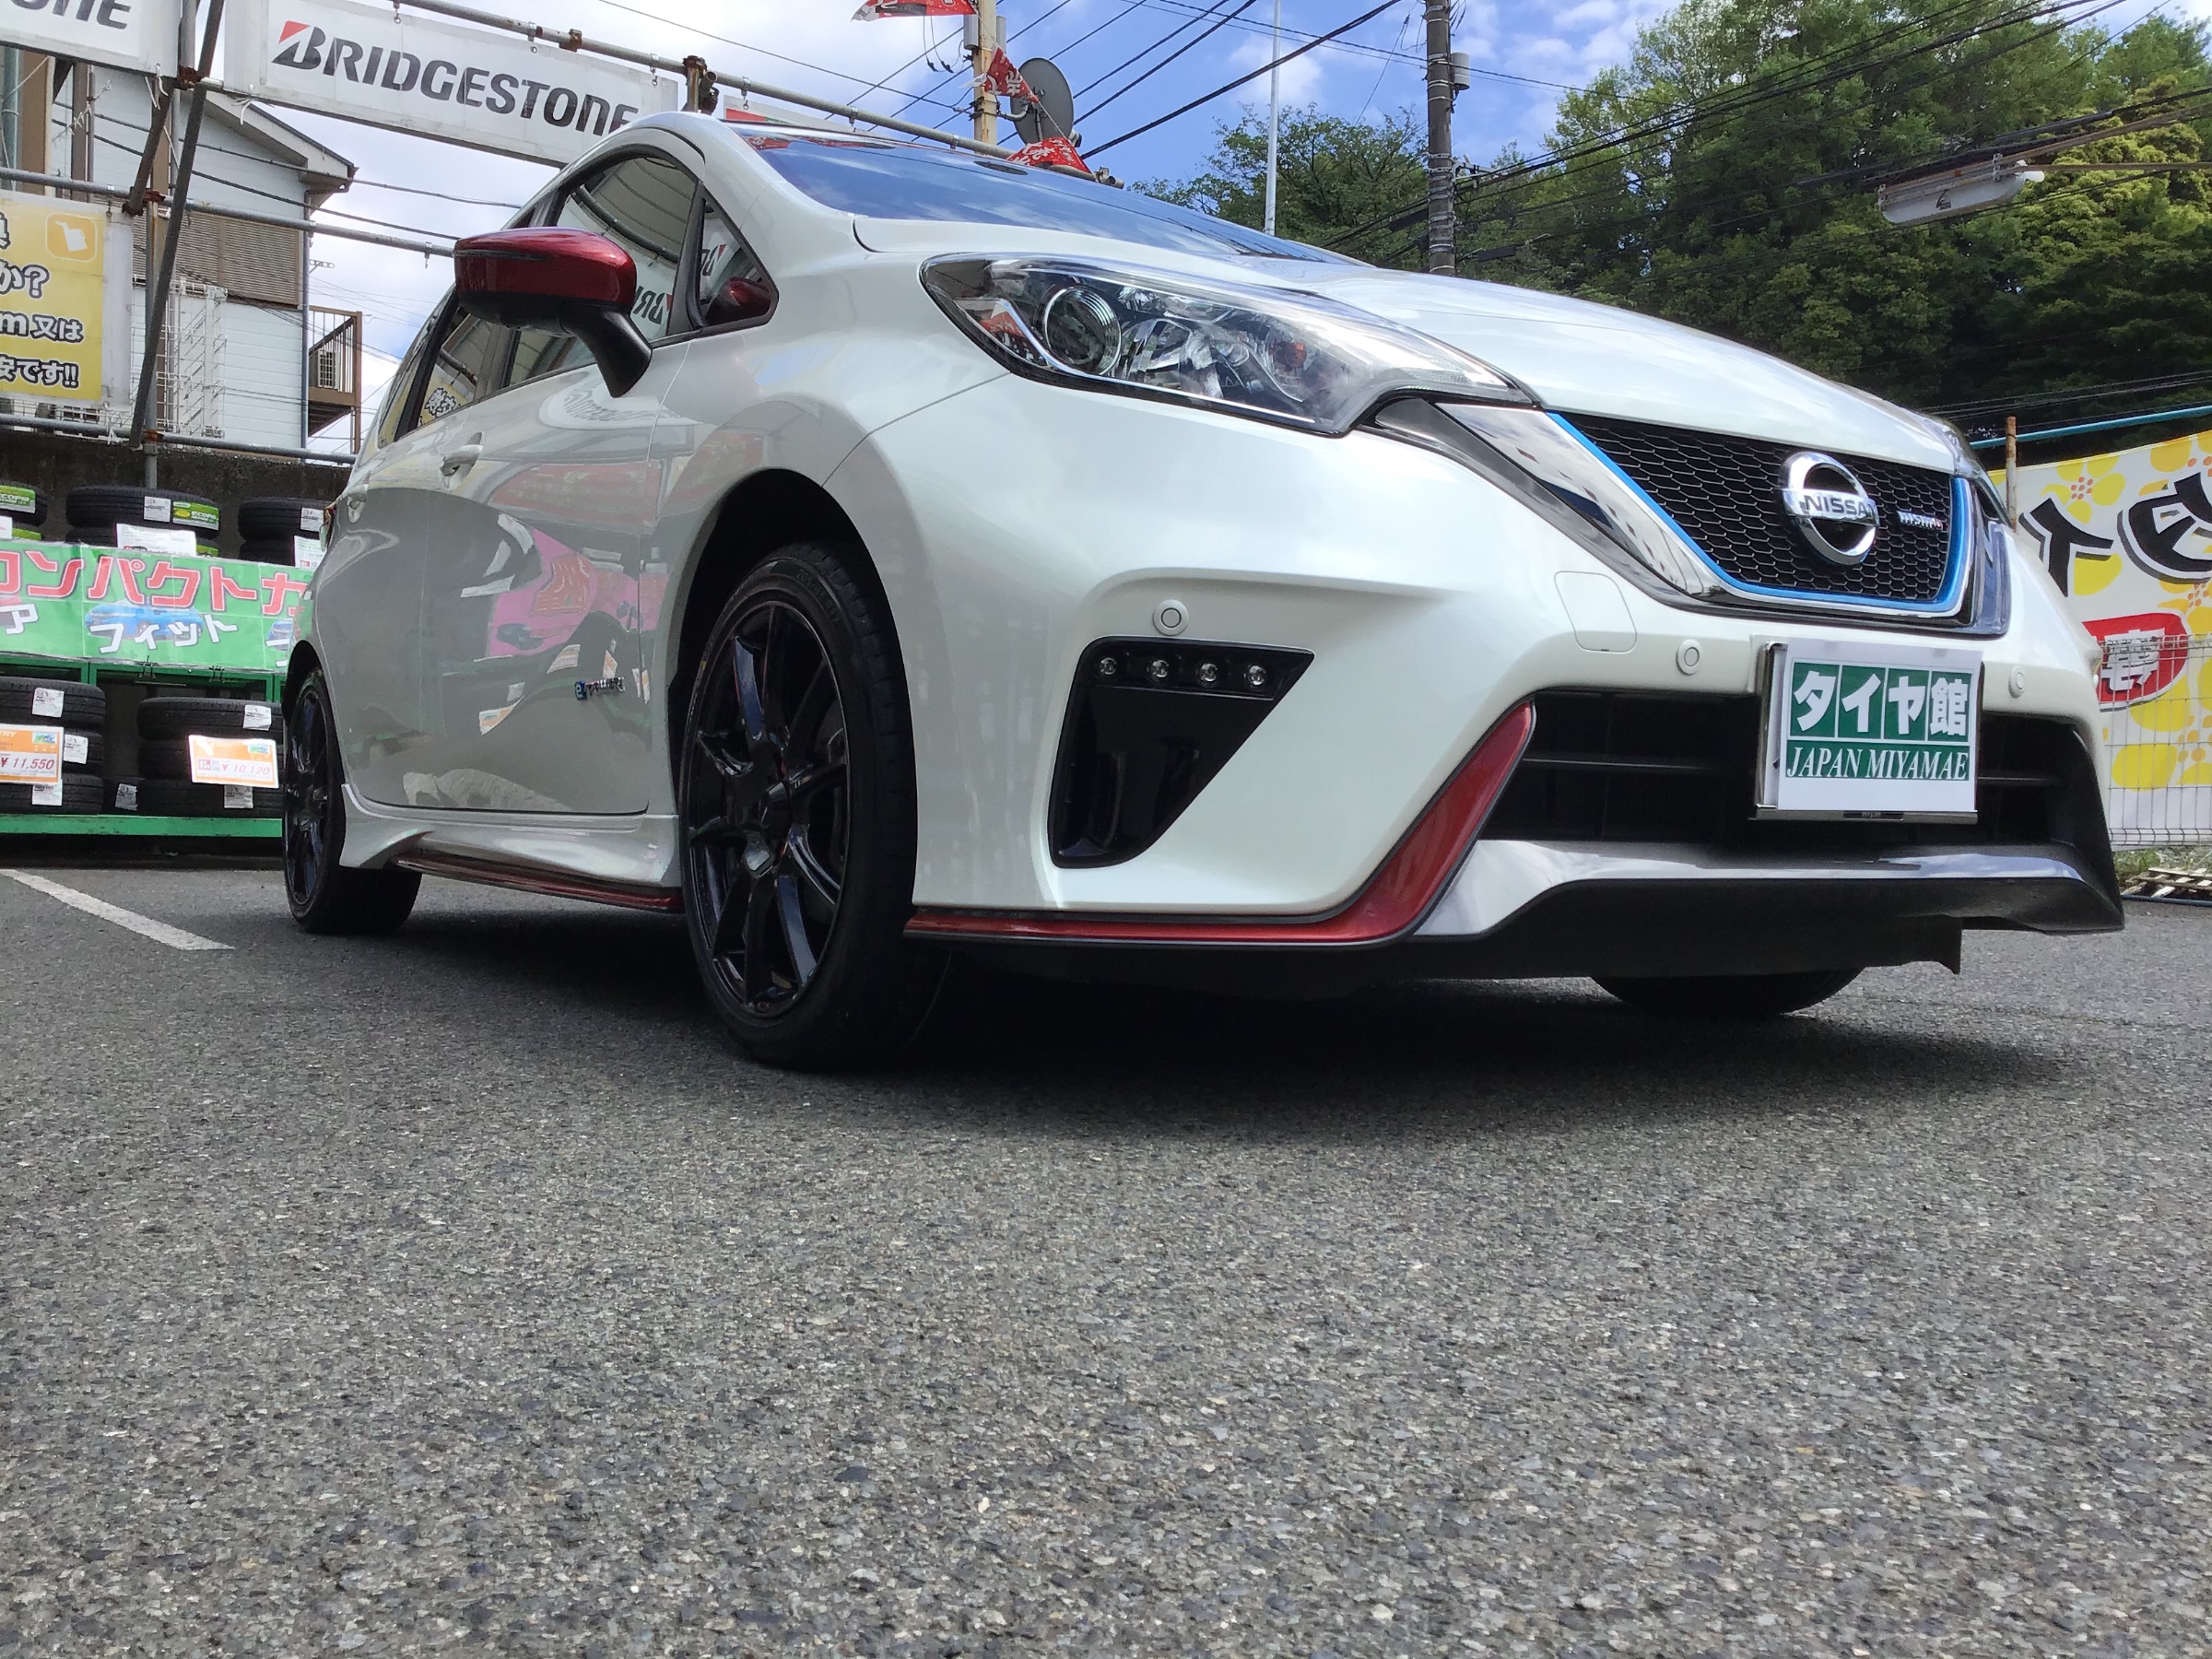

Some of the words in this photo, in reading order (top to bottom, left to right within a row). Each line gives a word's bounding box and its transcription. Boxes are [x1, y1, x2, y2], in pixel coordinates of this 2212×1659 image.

[271, 19, 639, 137] BRIDGESTONE
[1804, 494, 1877, 521] NISSAN
[89, 613, 238, 654] フィット
[1793, 669, 1969, 736] タイヤ館
[13, 757, 55, 770] 11,550
[233, 764, 270, 776] 10,120
[1786, 747, 1863, 778] JAPAN
[1865, 748, 1969, 781] MIYAMAE
